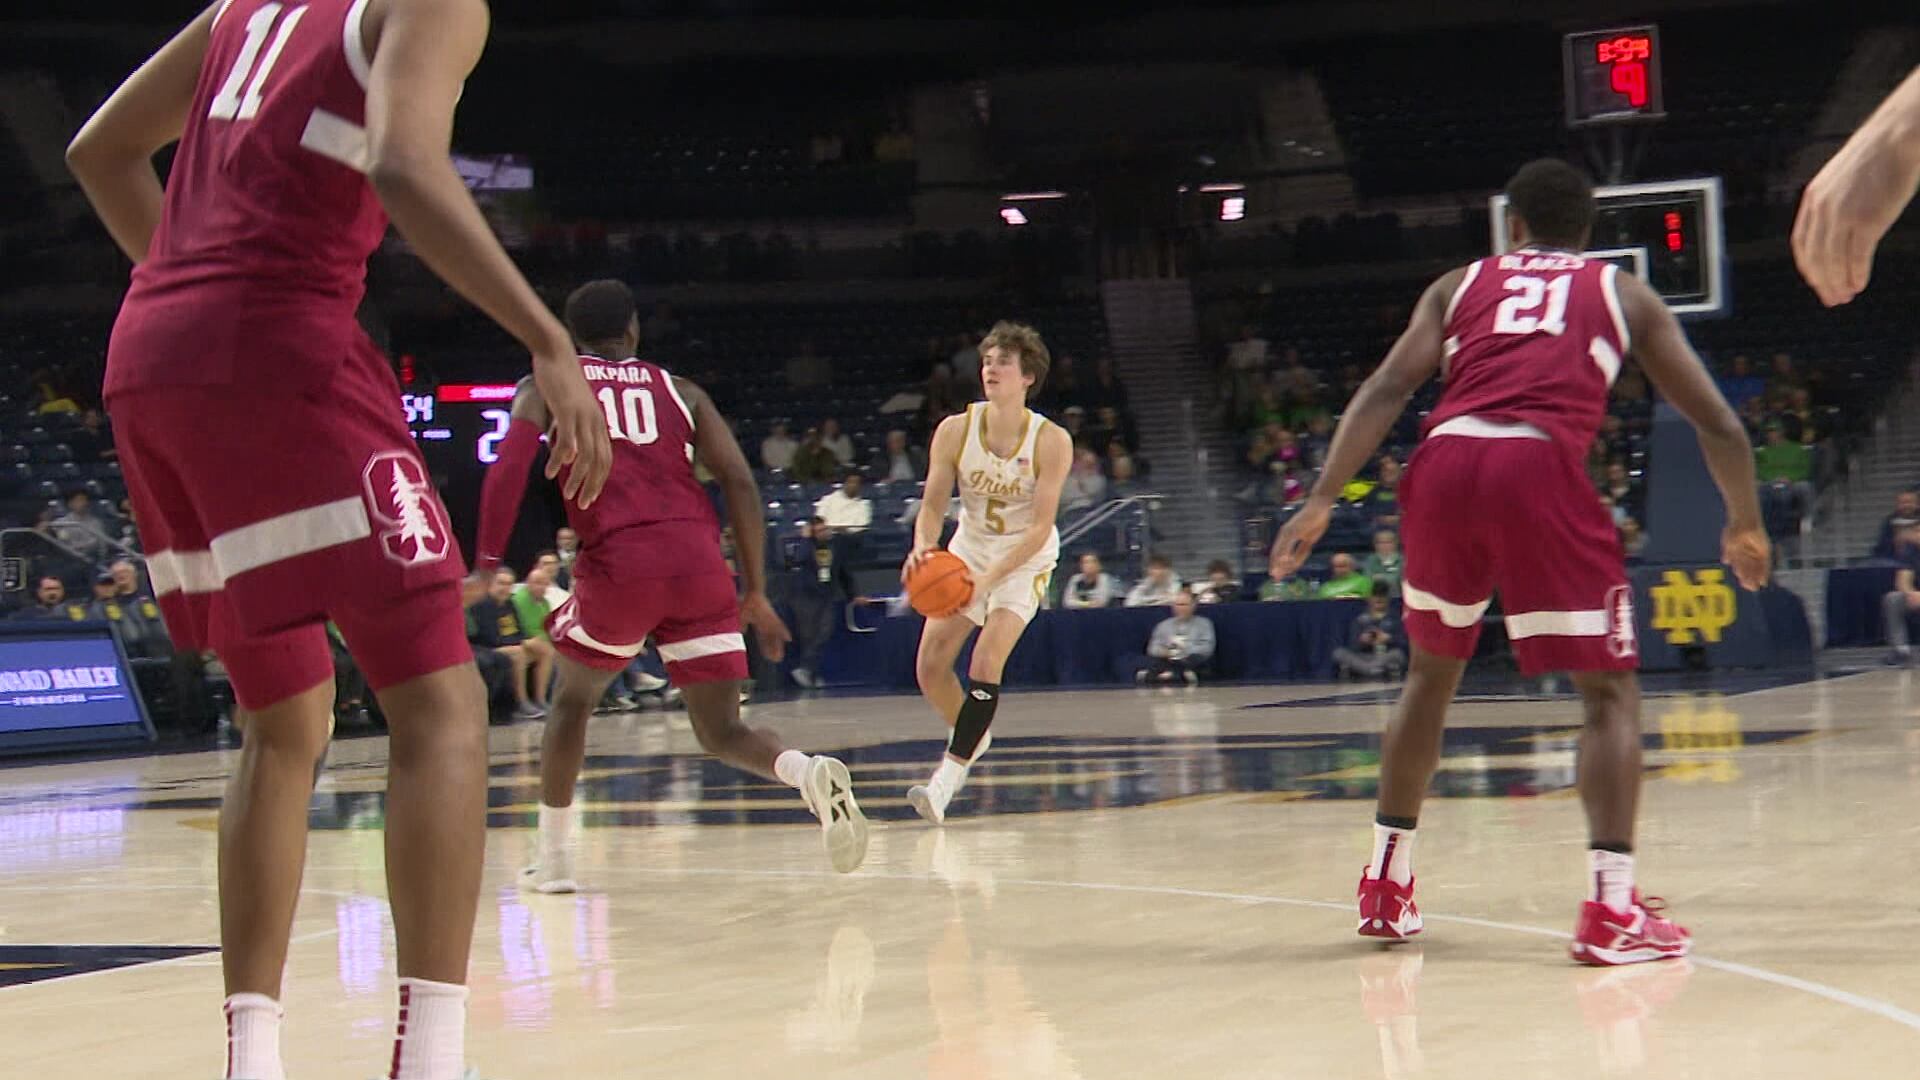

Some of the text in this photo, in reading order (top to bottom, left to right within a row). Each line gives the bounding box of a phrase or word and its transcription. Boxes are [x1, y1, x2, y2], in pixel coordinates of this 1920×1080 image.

[207, 2, 308, 119] 11
[1612, 62, 1647, 107] 9
[1493, 274, 1572, 336] 21
[584, 364, 653, 383] OKPARA
[598, 387, 659, 445] 10
[969, 470, 1022, 496] Irish
[986, 497, 1007, 535] 5
